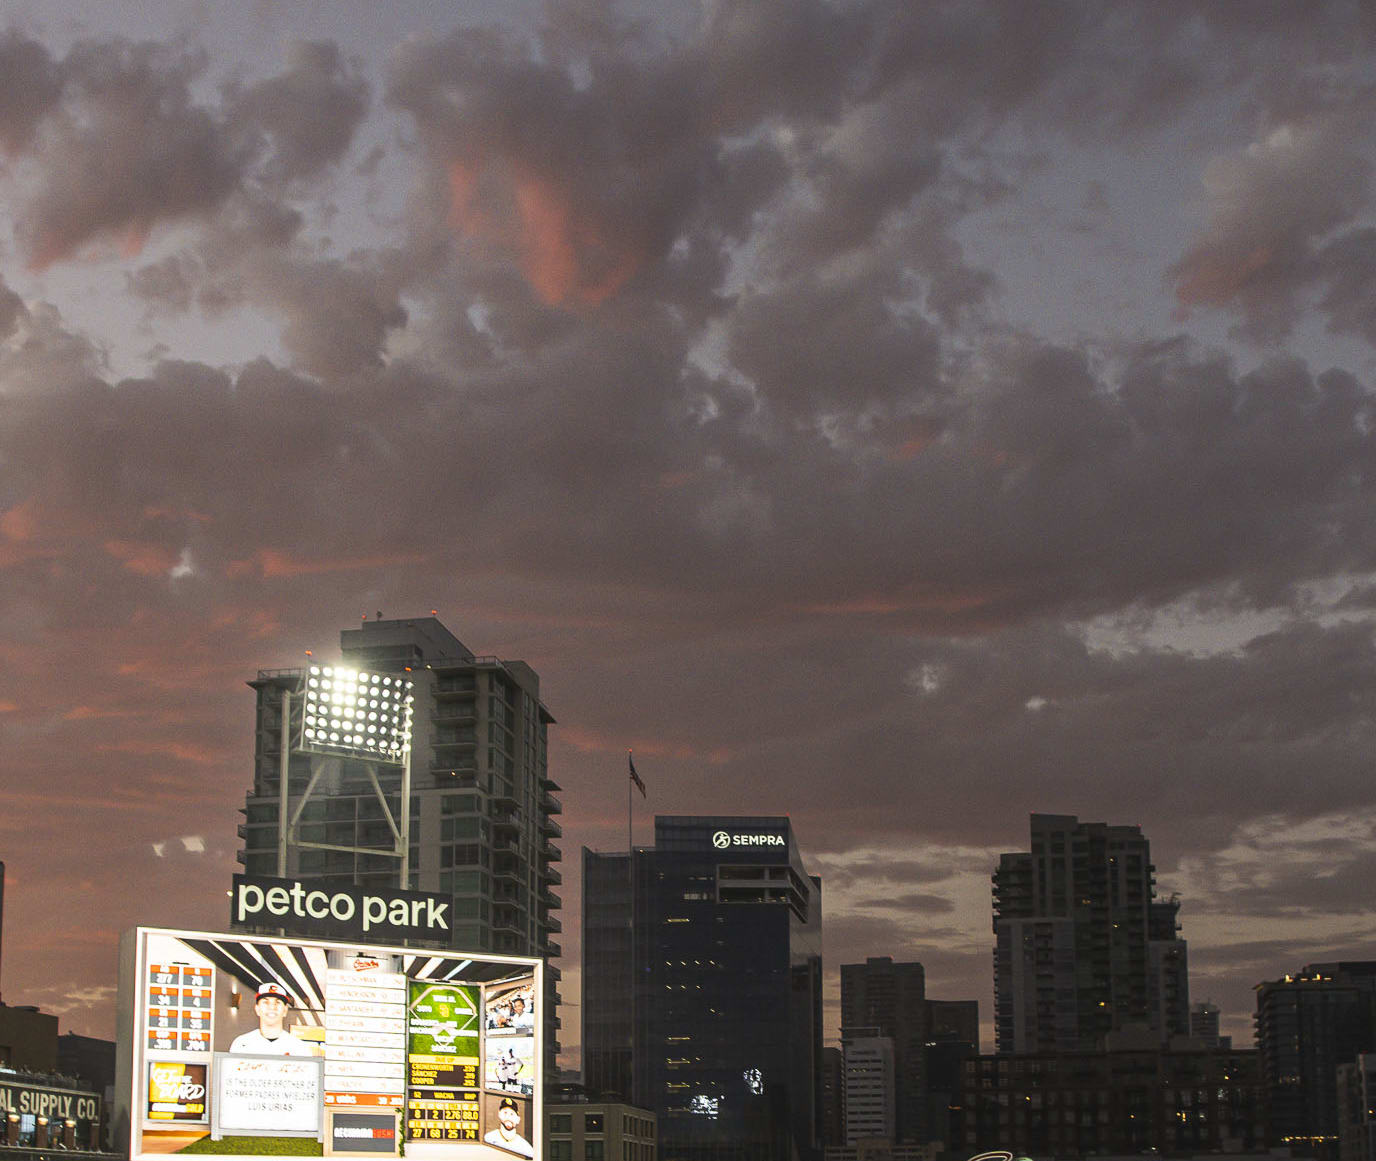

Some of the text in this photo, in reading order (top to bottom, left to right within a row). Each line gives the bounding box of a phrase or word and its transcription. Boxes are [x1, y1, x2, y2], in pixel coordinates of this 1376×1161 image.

[733, 835, 785, 845] SEMPRA
[238, 882, 449, 932] petco park
[20, 1091, 72, 1118] SUPPLY
[77, 1098, 99, 1121] CO.
